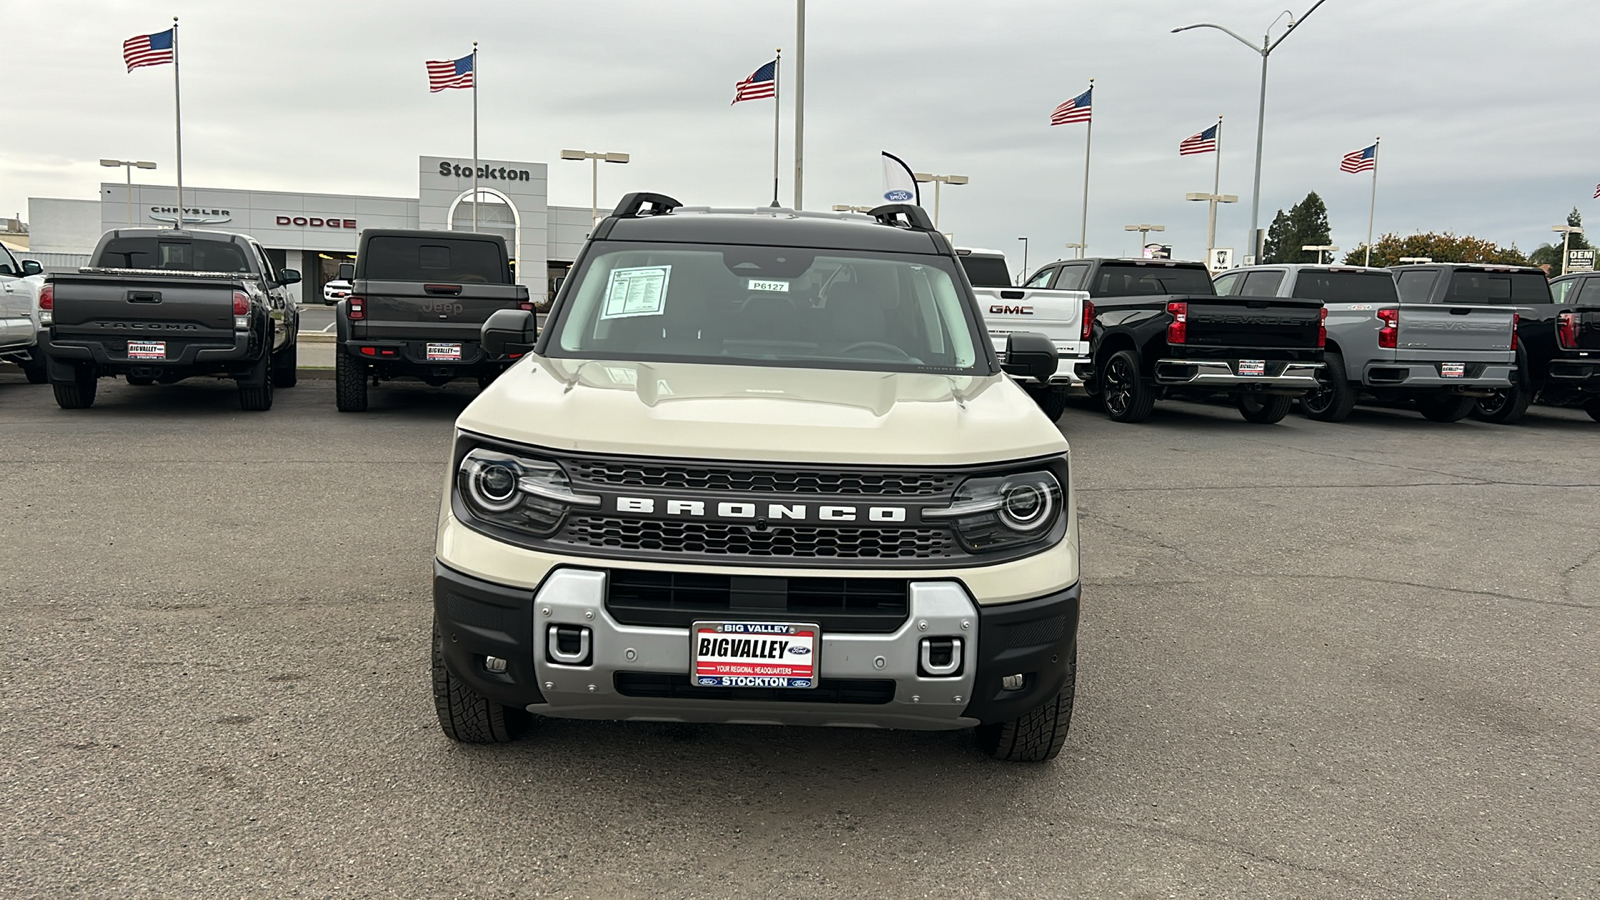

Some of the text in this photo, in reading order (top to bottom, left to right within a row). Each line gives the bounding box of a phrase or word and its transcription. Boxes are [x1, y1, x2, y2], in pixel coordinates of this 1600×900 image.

[439, 161, 530, 181] Stockton
[276, 215, 357, 229] DODGE
[1570, 251, 1593, 259] OEM
[753, 282, 785, 291] P6127
[422, 299, 463, 315] Jeep
[989, 305, 1034, 315] GMC
[94, 321, 198, 332] TACOMA
[616, 496, 907, 523] BRONCO
[724, 624, 789, 634] BIG VALLEY
[699, 638, 789, 659] BIGVALLEY
[754, 666, 792, 675] HEADQUARTERS
[722, 677, 788, 687] STOCKTON
